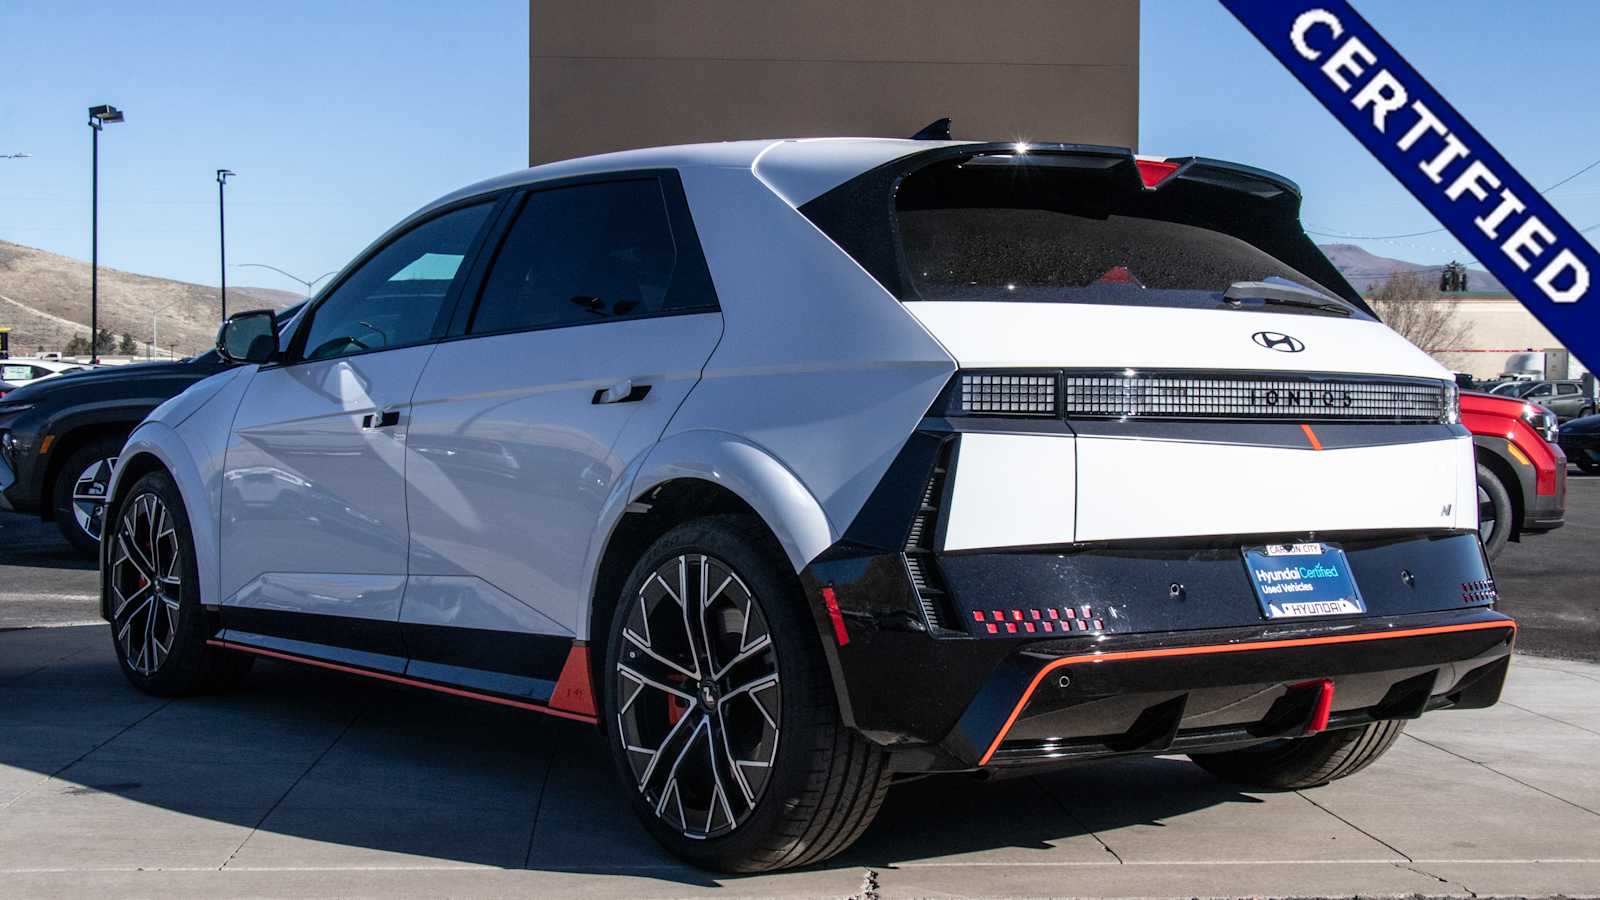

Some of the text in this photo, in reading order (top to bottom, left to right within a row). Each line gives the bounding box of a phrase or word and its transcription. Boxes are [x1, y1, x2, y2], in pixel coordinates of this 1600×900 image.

[1270, 544, 1318, 553] CARON CITY
[1257, 563, 1338, 582] Hyundai Certified
[1262, 582, 1313, 594] Used Vehicles
[1292, 602, 1341, 615] HYUNDAI
